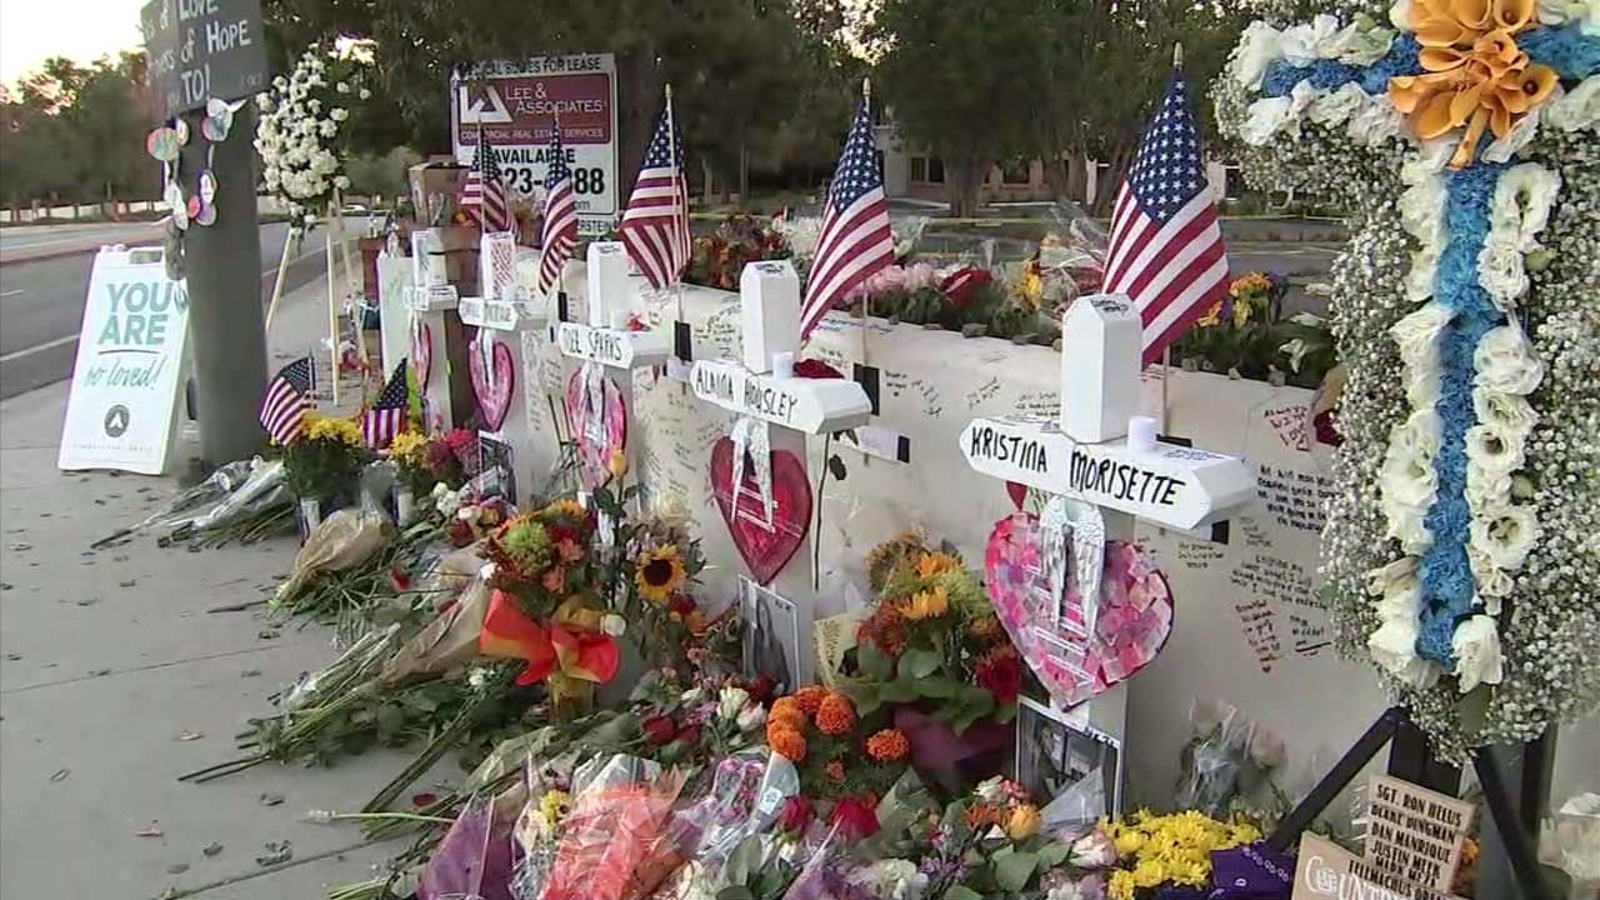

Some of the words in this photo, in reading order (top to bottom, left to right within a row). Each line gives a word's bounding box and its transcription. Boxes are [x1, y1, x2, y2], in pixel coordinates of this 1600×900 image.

[181, 28, 196, 63] of
[206, 20, 252, 54] HOPE
[568, 57, 601, 71] LEASE
[505, 86, 532, 101] LEE
[535, 82, 547, 99] &
[516, 99, 603, 115] ASSOCIATES
[107, 282, 174, 313] YOU
[98, 314, 169, 346] ARE
[970, 426, 1049, 473] KRISTINA
[1070, 450, 1187, 506] MORISETTE
[1376, 784, 1400, 806] SGT.
[1402, 793, 1426, 813] RON
[1371, 822, 1394, 841] DAN
[1395, 827, 1453, 864] MANRIQUE
[1406, 814, 1456, 845] DINGMAN
[1371, 841, 1410, 864] JUSTIN
[1411, 853, 1441, 879] MEEK
